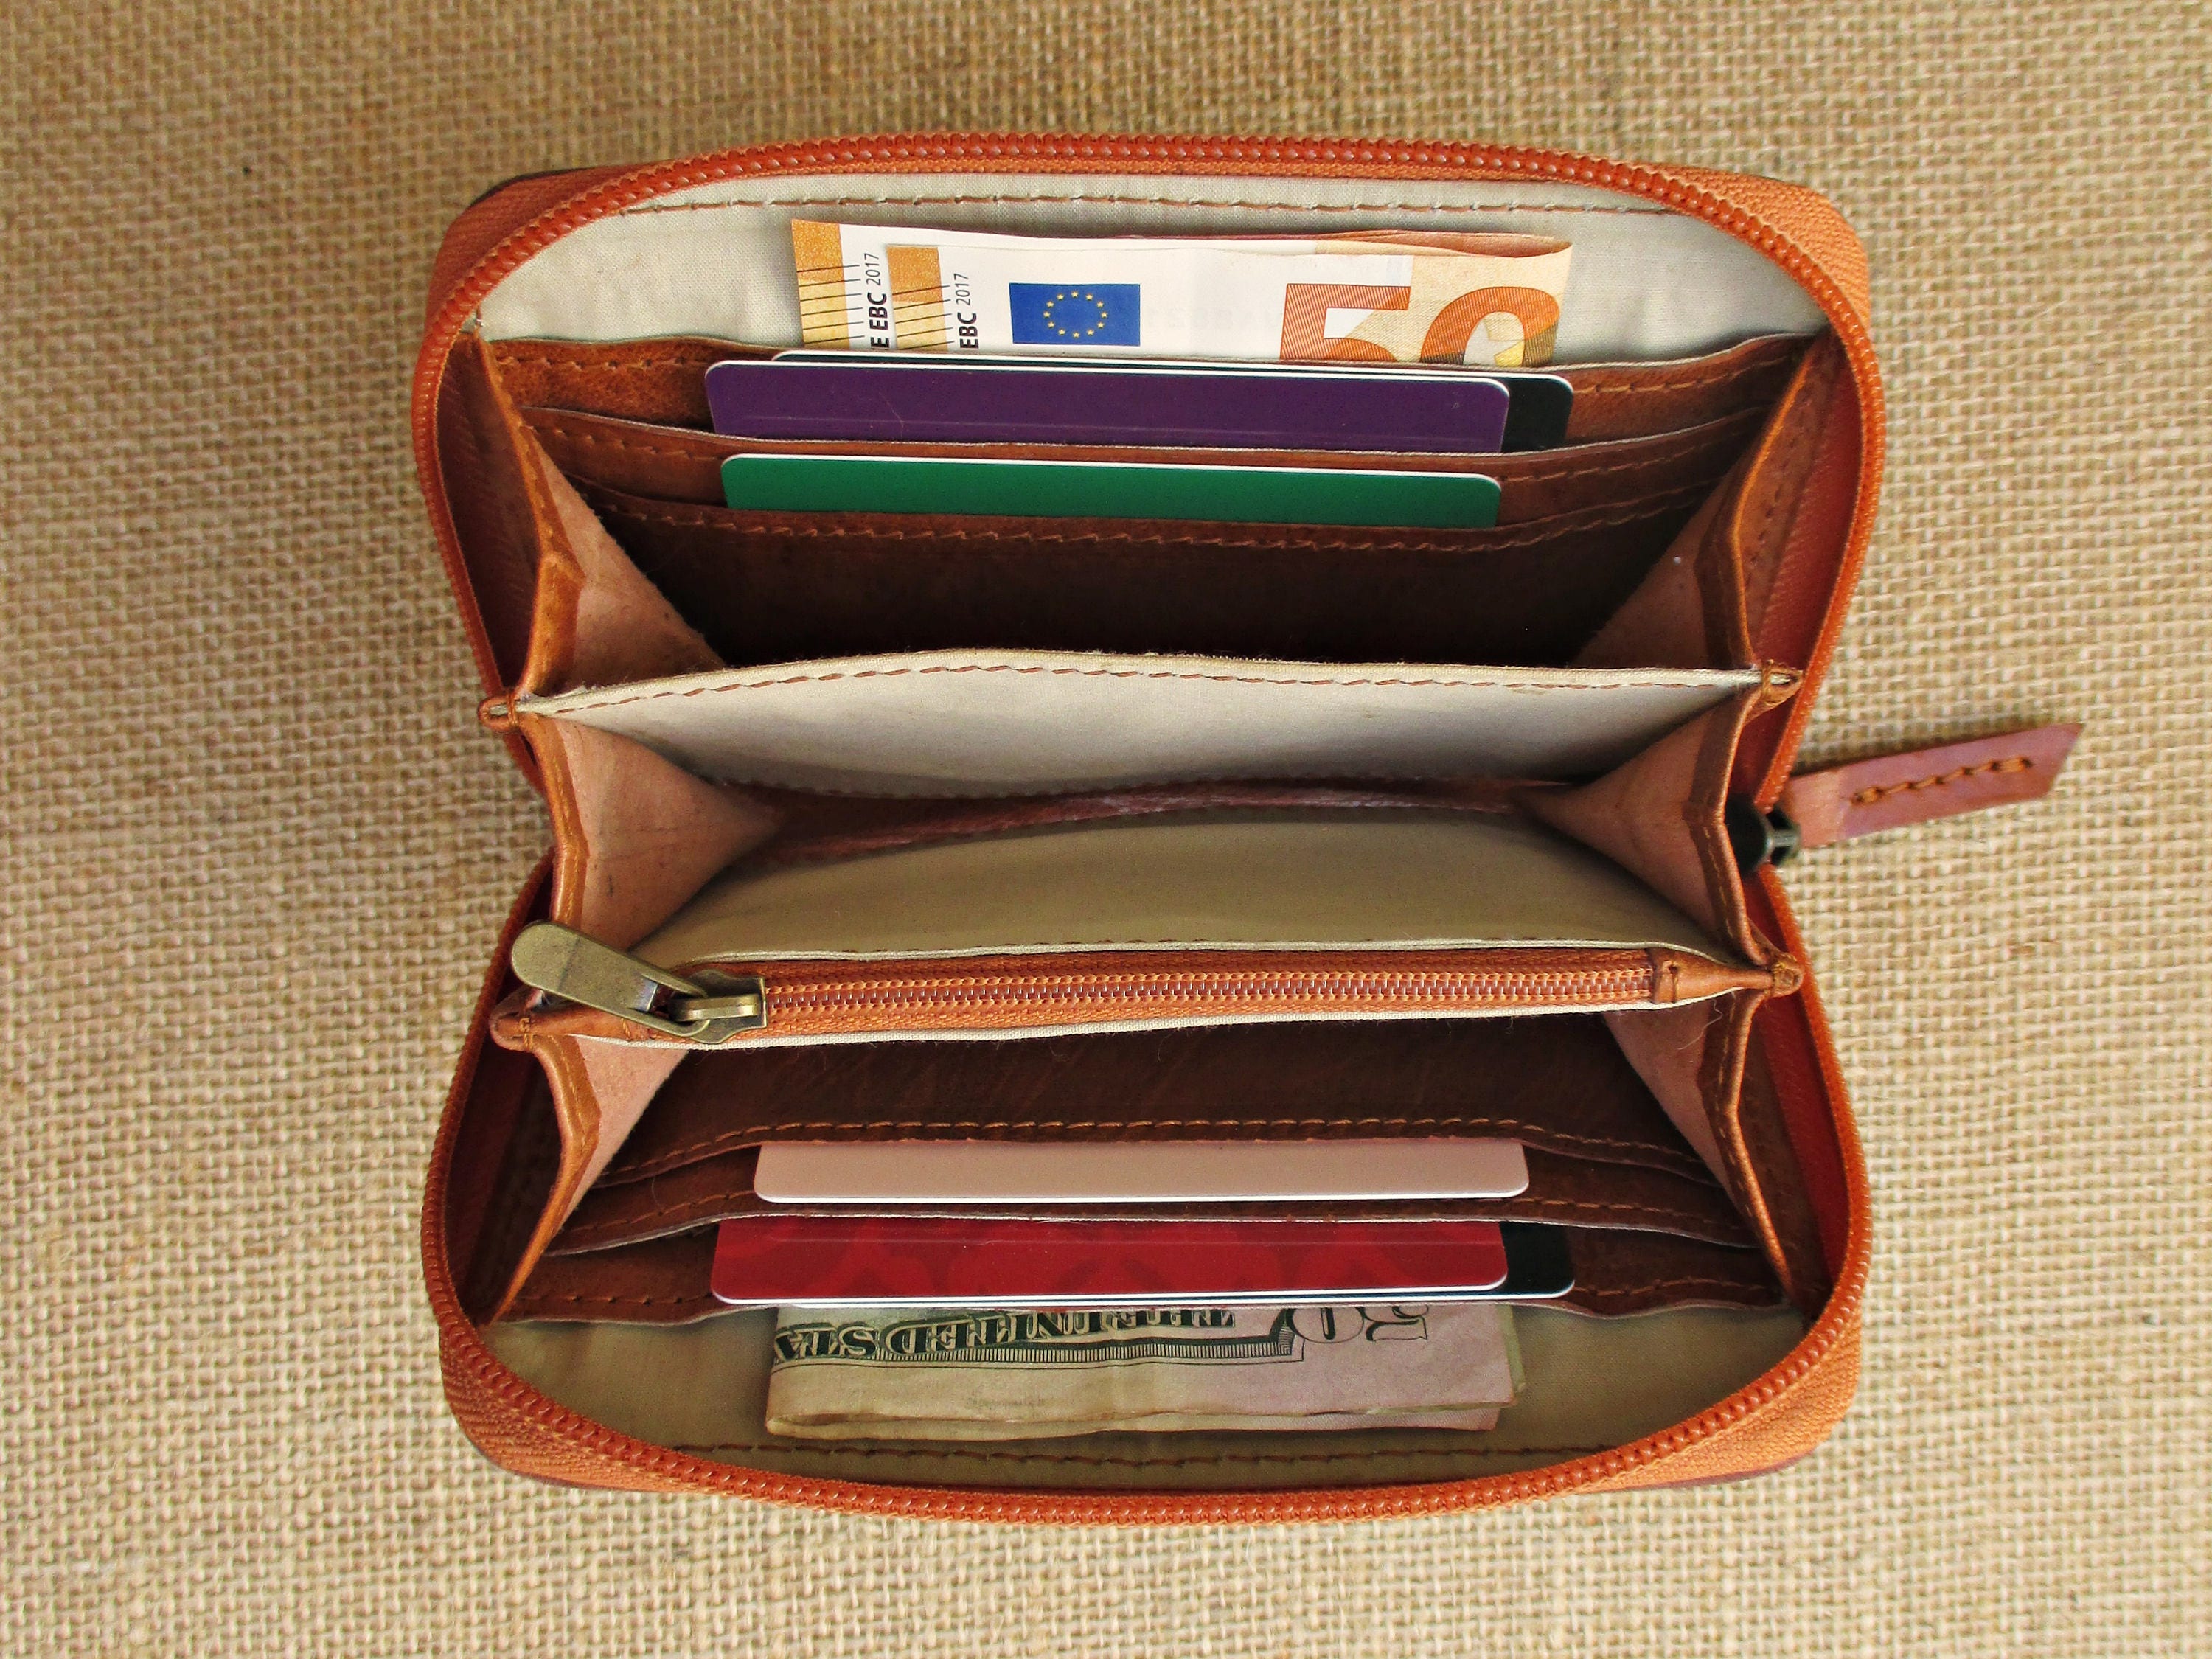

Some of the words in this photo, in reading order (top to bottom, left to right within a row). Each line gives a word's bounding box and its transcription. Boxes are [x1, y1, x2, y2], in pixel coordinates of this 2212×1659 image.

[864, 253, 881, 286] 2017
[954, 273, 971, 306] 2017
[867, 292, 888, 330] EBC
[957, 312, 979, 349] EBC
[886, 1311, 1105, 1355] UNITED
